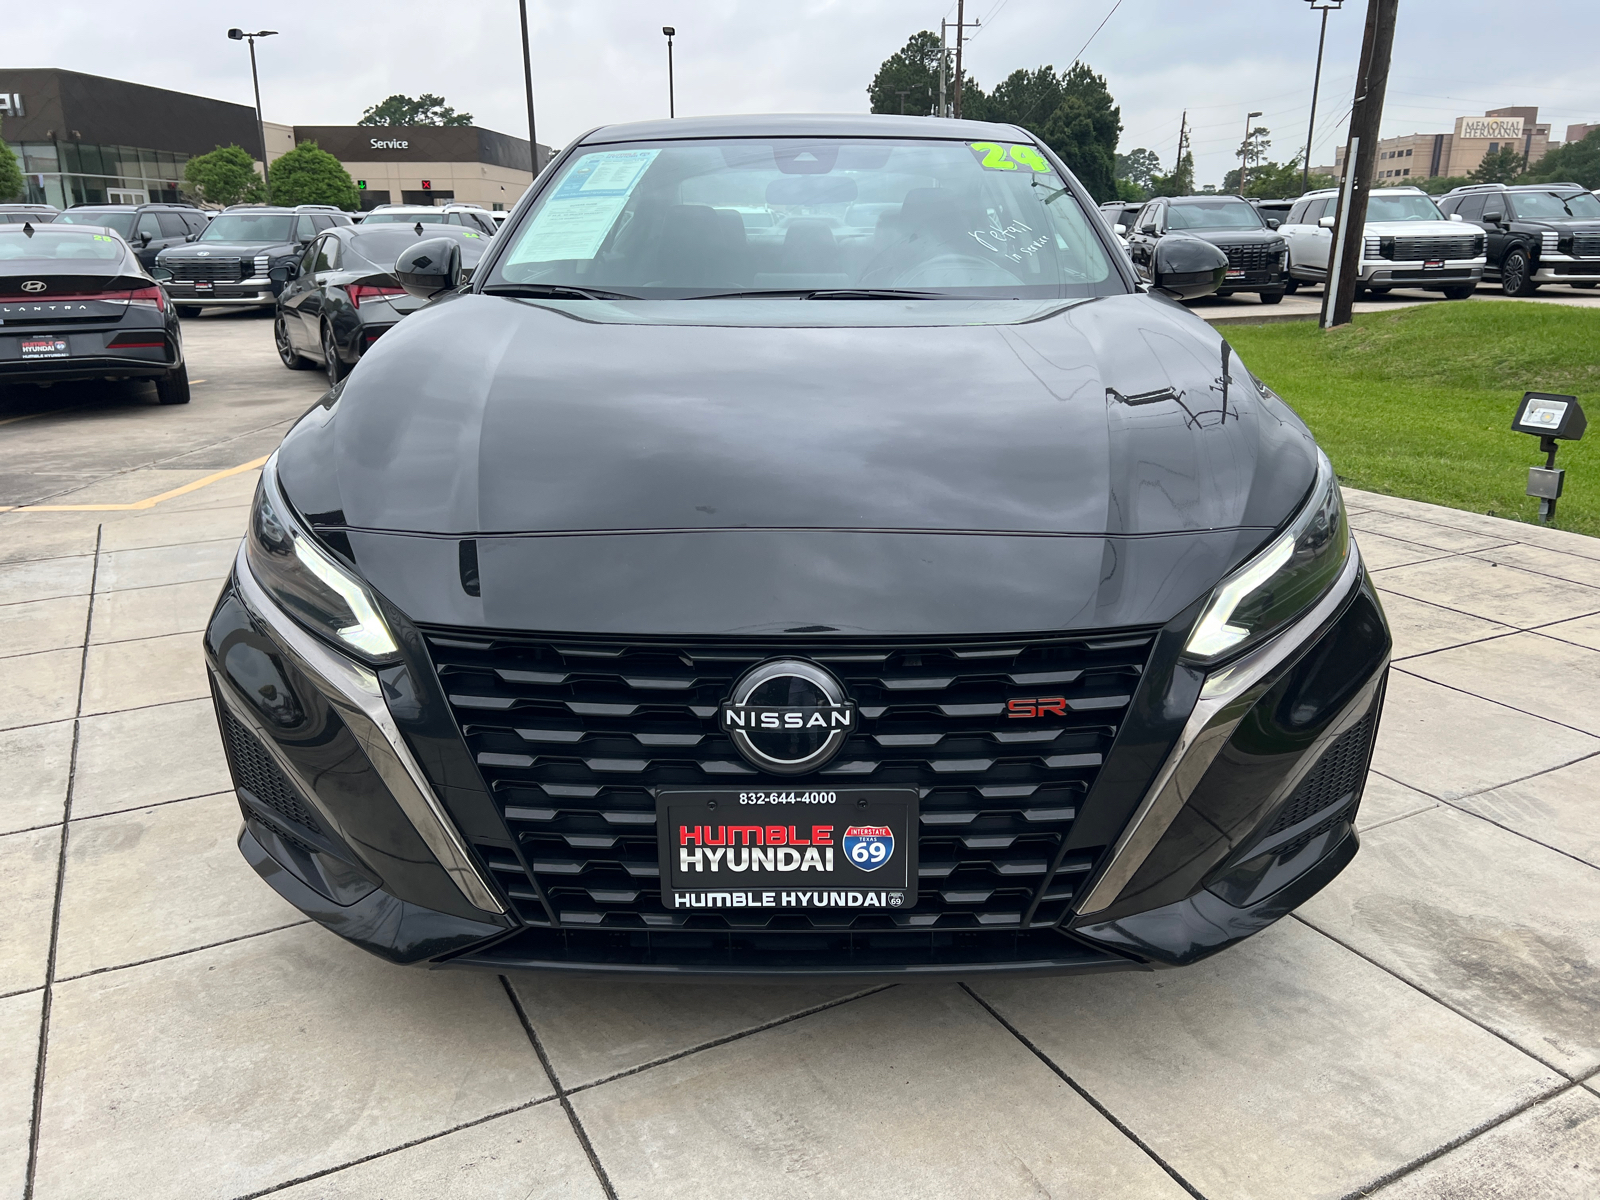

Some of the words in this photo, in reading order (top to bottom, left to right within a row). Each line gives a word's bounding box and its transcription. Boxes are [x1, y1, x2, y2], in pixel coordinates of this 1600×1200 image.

[1464, 128, 1519, 138] HERMANN
[1465, 121, 1520, 131] MEMORIAL
[370, 138, 409, 149] Service
[970, 142, 1051, 173] 24
[1008, 698, 1067, 718] SR
[726, 709, 850, 728] NISSAN
[739, 792, 837, 805] 832-644-4000
[679, 825, 834, 846] HUMBLE
[850, 828, 887, 836] INTERSTATE
[679, 847, 834, 872] HYUNDAI
[851, 842, 887, 863] 69
[674, 892, 776, 908] HUMBLE
[781, 892, 887, 907] HYUNDAI
